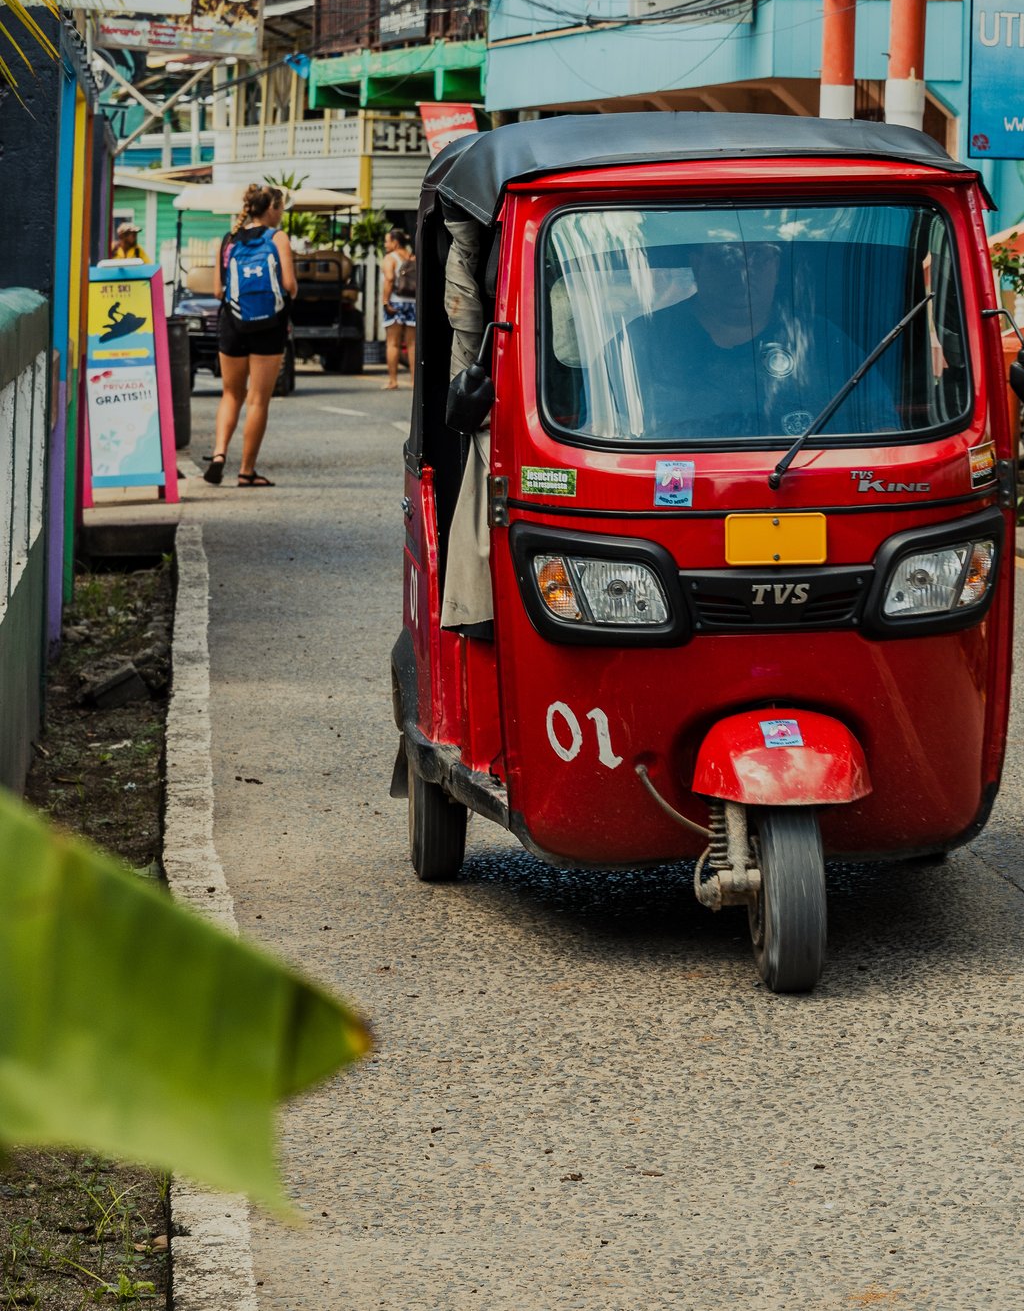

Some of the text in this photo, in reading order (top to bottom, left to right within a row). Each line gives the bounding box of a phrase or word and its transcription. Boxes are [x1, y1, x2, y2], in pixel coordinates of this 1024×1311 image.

[424, 111, 474, 132] Helados
[100, 284, 131, 294] JET SKI
[103, 382, 145, 390] PRIVADA
[95, 389, 152, 406] GRATIS!!!
[527, 469, 568, 483] Jesucristo
[850, 470, 874, 480] TVS
[857, 479, 931, 493] KING
[751, 583, 811, 605] TVS
[545, 700, 624, 770] 01
